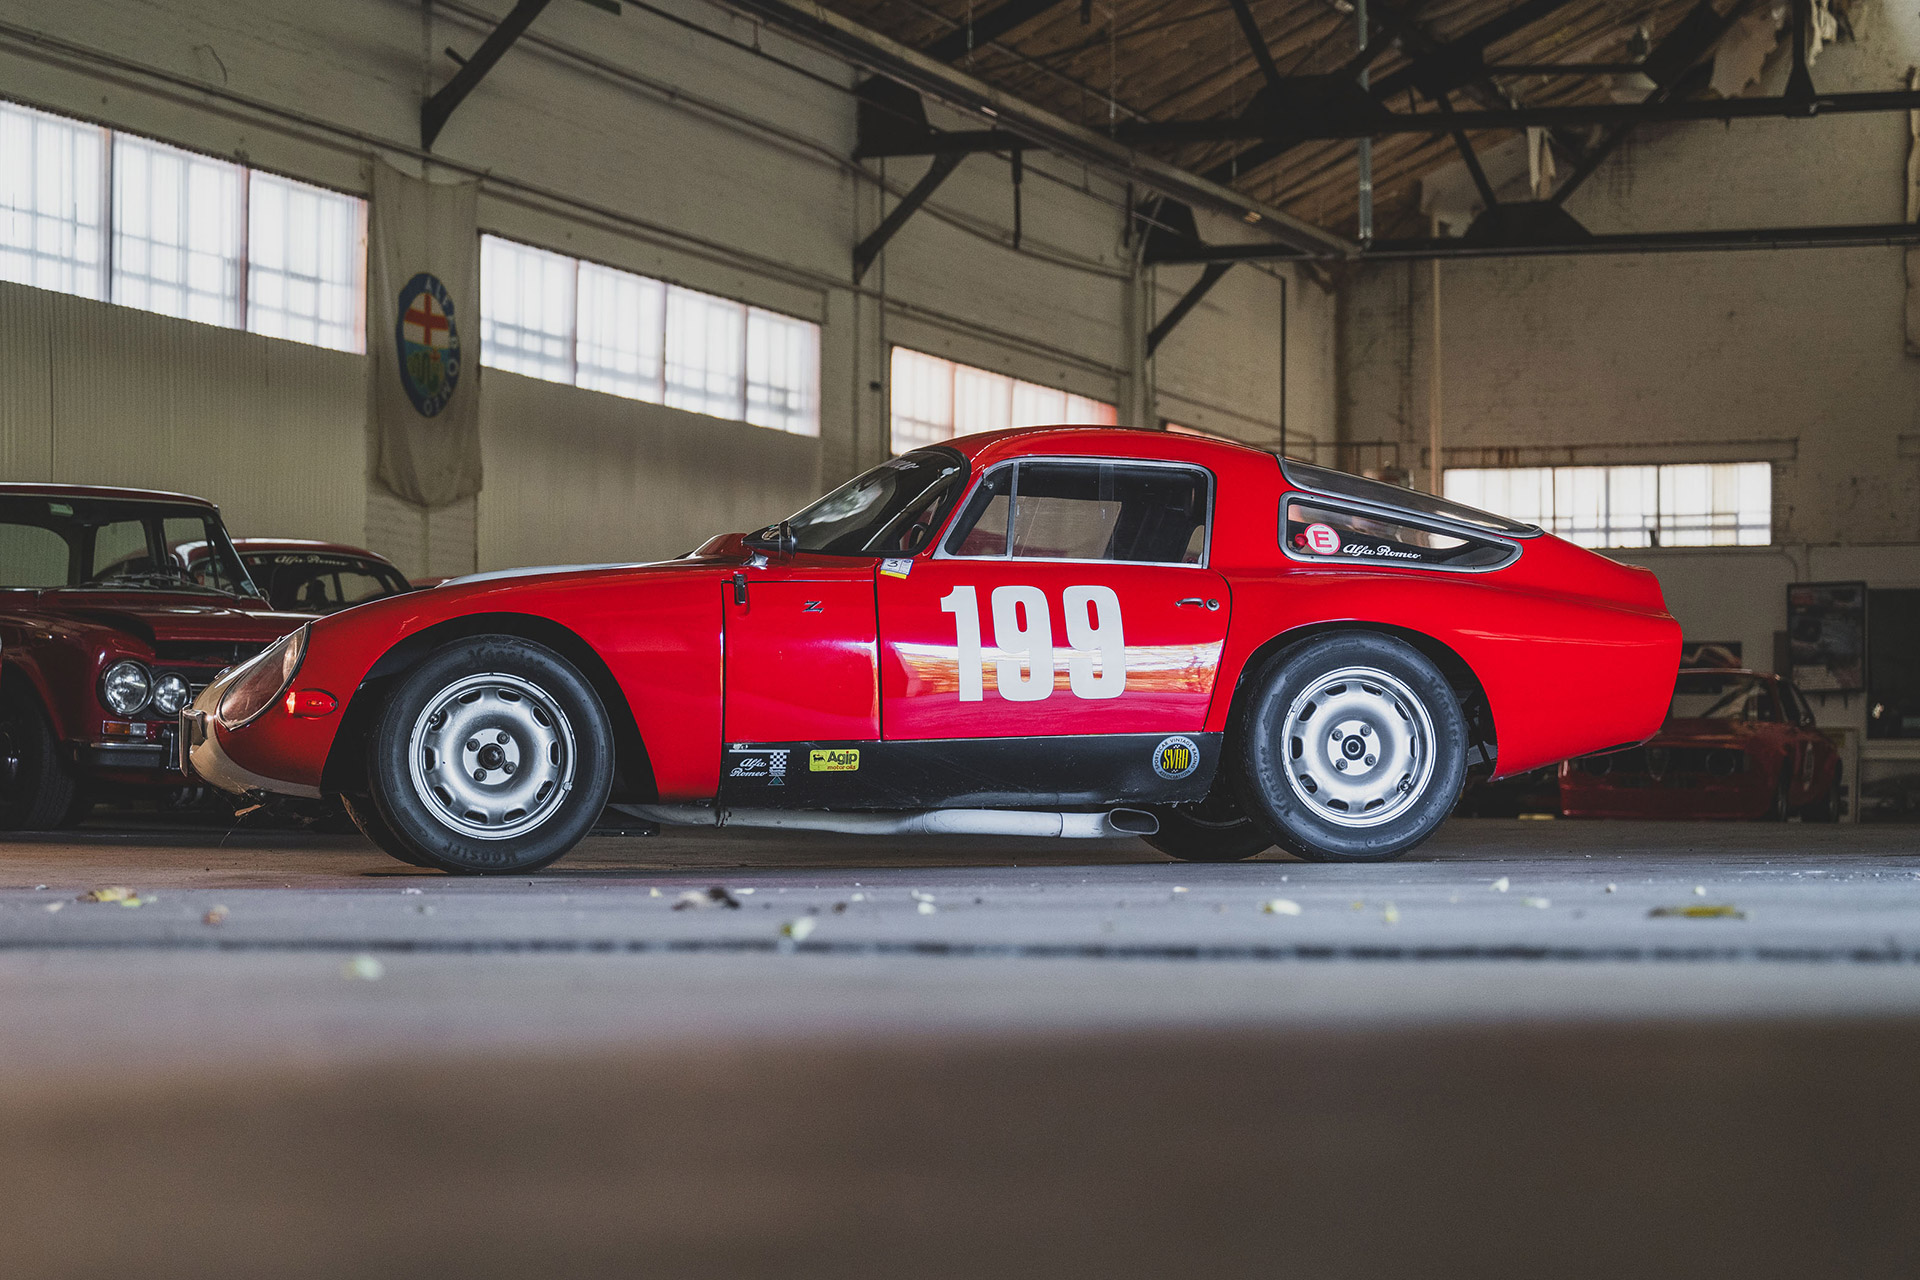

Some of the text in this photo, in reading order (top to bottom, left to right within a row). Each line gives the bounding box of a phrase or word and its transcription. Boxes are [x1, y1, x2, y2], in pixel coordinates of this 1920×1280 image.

[1312, 530, 1333, 548] E
[1342, 543, 1421, 559] Alfa Romeo
[274, 555, 303, 566] Alfa
[802, 599, 824, 614] Z
[940, 585, 1126, 702] 199
[1170, 738, 1193, 748] VINTAGE
[739, 758, 767, 771] Alfa
[827, 751, 858, 765] Agip
[1163, 748, 1189, 770] SVRA
[730, 767, 768, 777] Romeo
